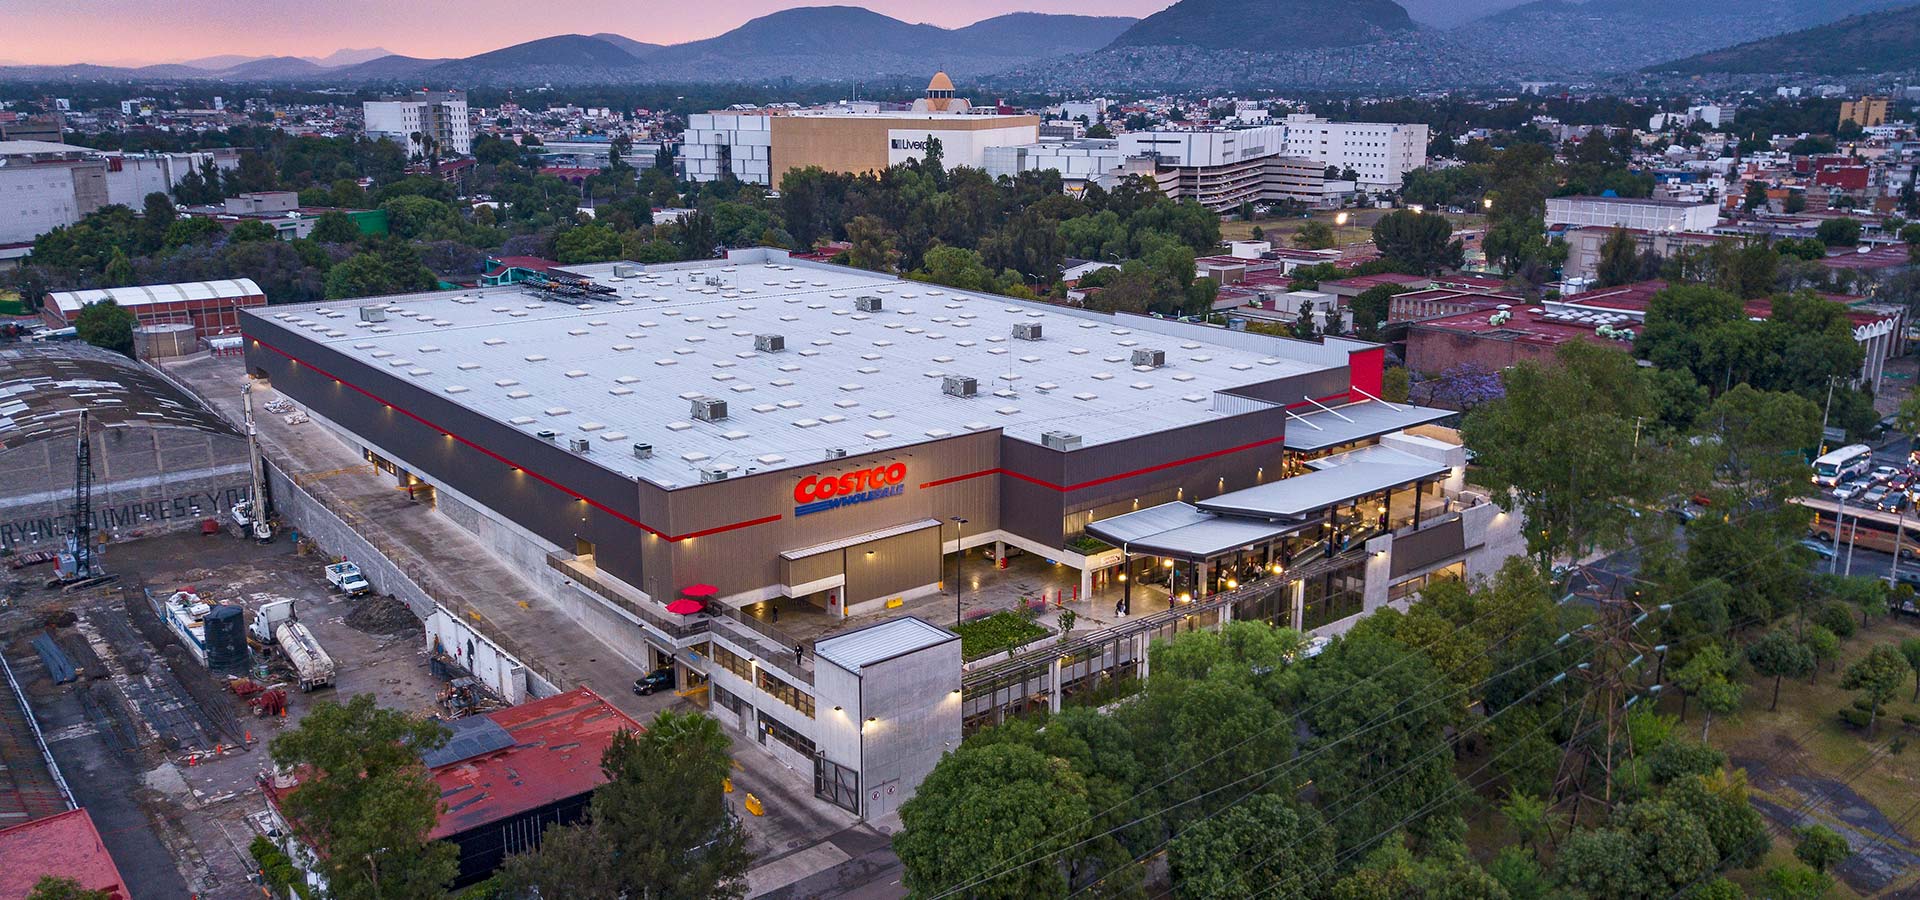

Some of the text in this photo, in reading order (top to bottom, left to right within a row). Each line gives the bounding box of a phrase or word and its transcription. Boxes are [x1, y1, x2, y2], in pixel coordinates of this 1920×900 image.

[794, 463, 907, 503] COSTCO
[828, 484, 905, 509] WHOLESALE
[102, 494, 201, 529] IMPRESS
